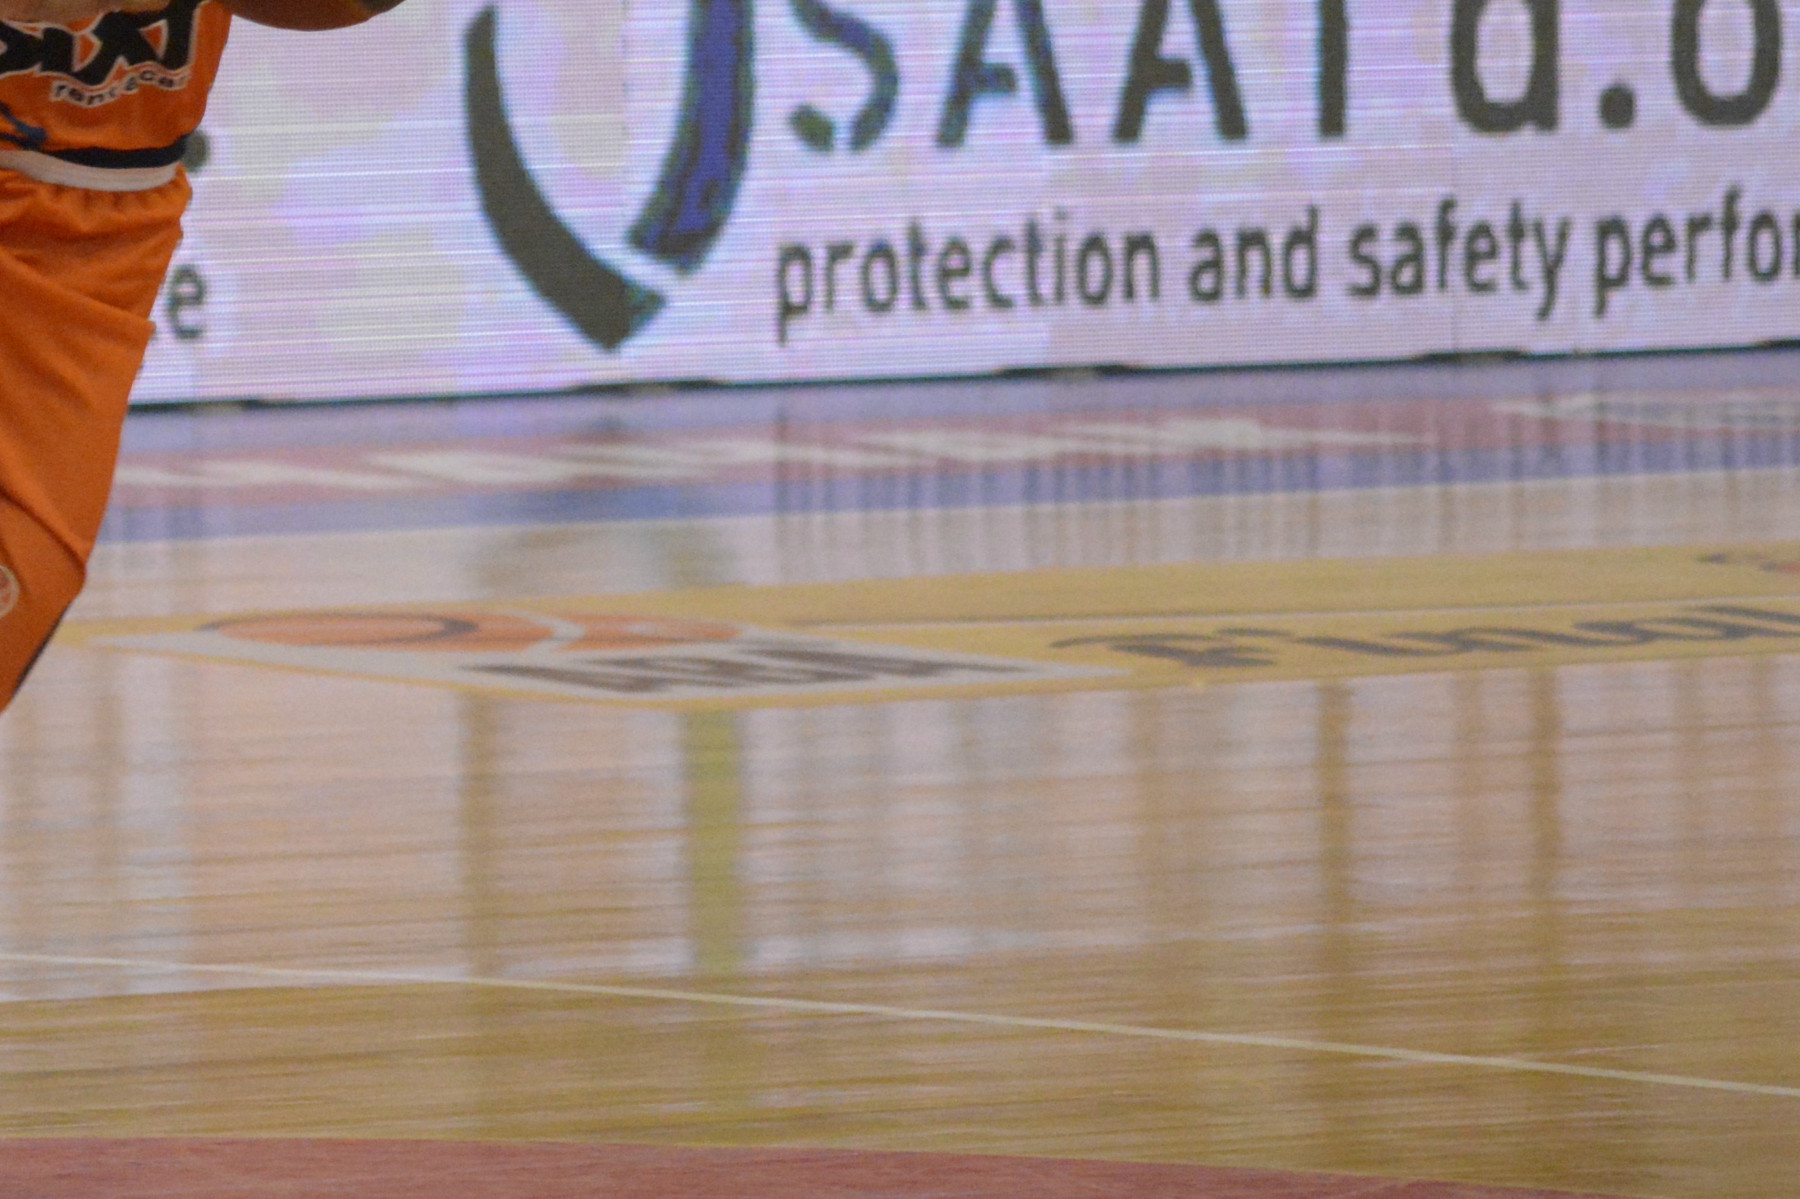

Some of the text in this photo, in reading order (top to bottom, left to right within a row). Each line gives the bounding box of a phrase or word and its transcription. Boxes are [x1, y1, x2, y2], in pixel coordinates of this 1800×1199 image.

[776, 206, 1164, 345] protection
[1188, 204, 1320, 303] and
[1346, 195, 1571, 321] safety
